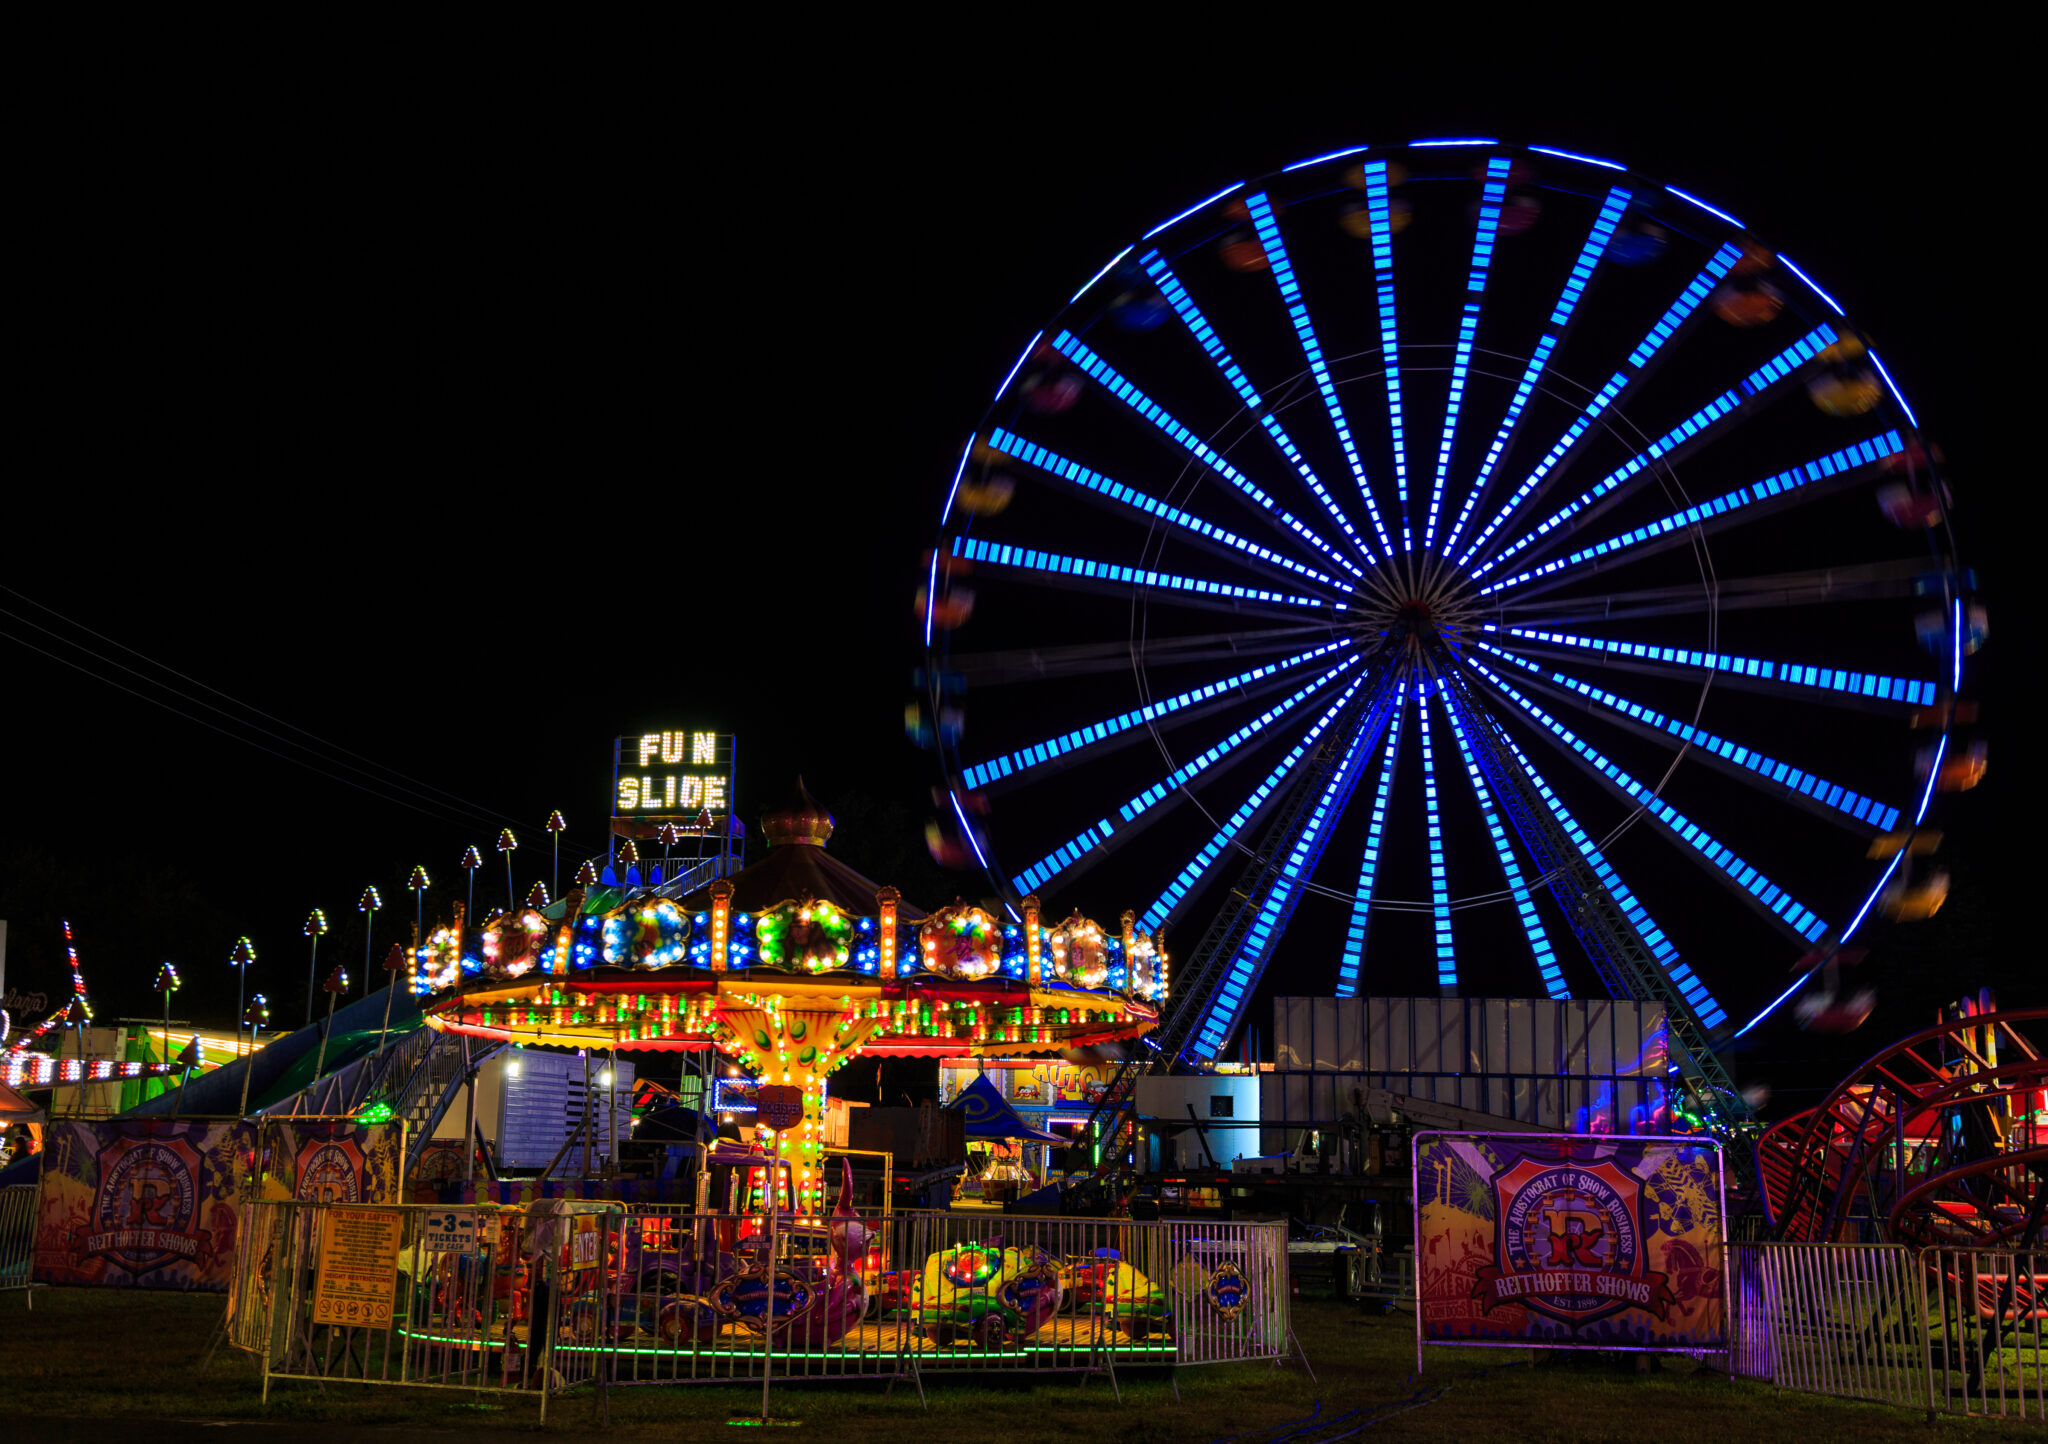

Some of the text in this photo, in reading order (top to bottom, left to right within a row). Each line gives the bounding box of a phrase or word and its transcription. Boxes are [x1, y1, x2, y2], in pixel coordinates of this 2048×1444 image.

[640, 731, 716, 767] FUN
[618, 775, 726, 809] SLIDE
[1033, 1064, 1100, 1093] AUTO
[761, 1102, 801, 1114] TICKETS PER
[771, 1114, 790, 1126] RIDER
[156, 1148, 181, 1171] SHOW
[329, 1210, 343, 1219] FOR
[345, 1211, 366, 1220] YOUR
[444, 1214, 456, 1232] 3
[1508, 1173, 1633, 1256] THE ARISTOCRAT OF SHOW BUSINESS
[88, 1230, 198, 1256] REITHOFFER SHOWS
[428, 1233, 471, 1243] TICKETS
[574, 1231, 600, 1263] ENTER
[1494, 1272, 1593, 1298] REITHOFFER
[1596, 1274, 1651, 1303] SHOWS
[1577, 1298, 1598, 1309] 1896
